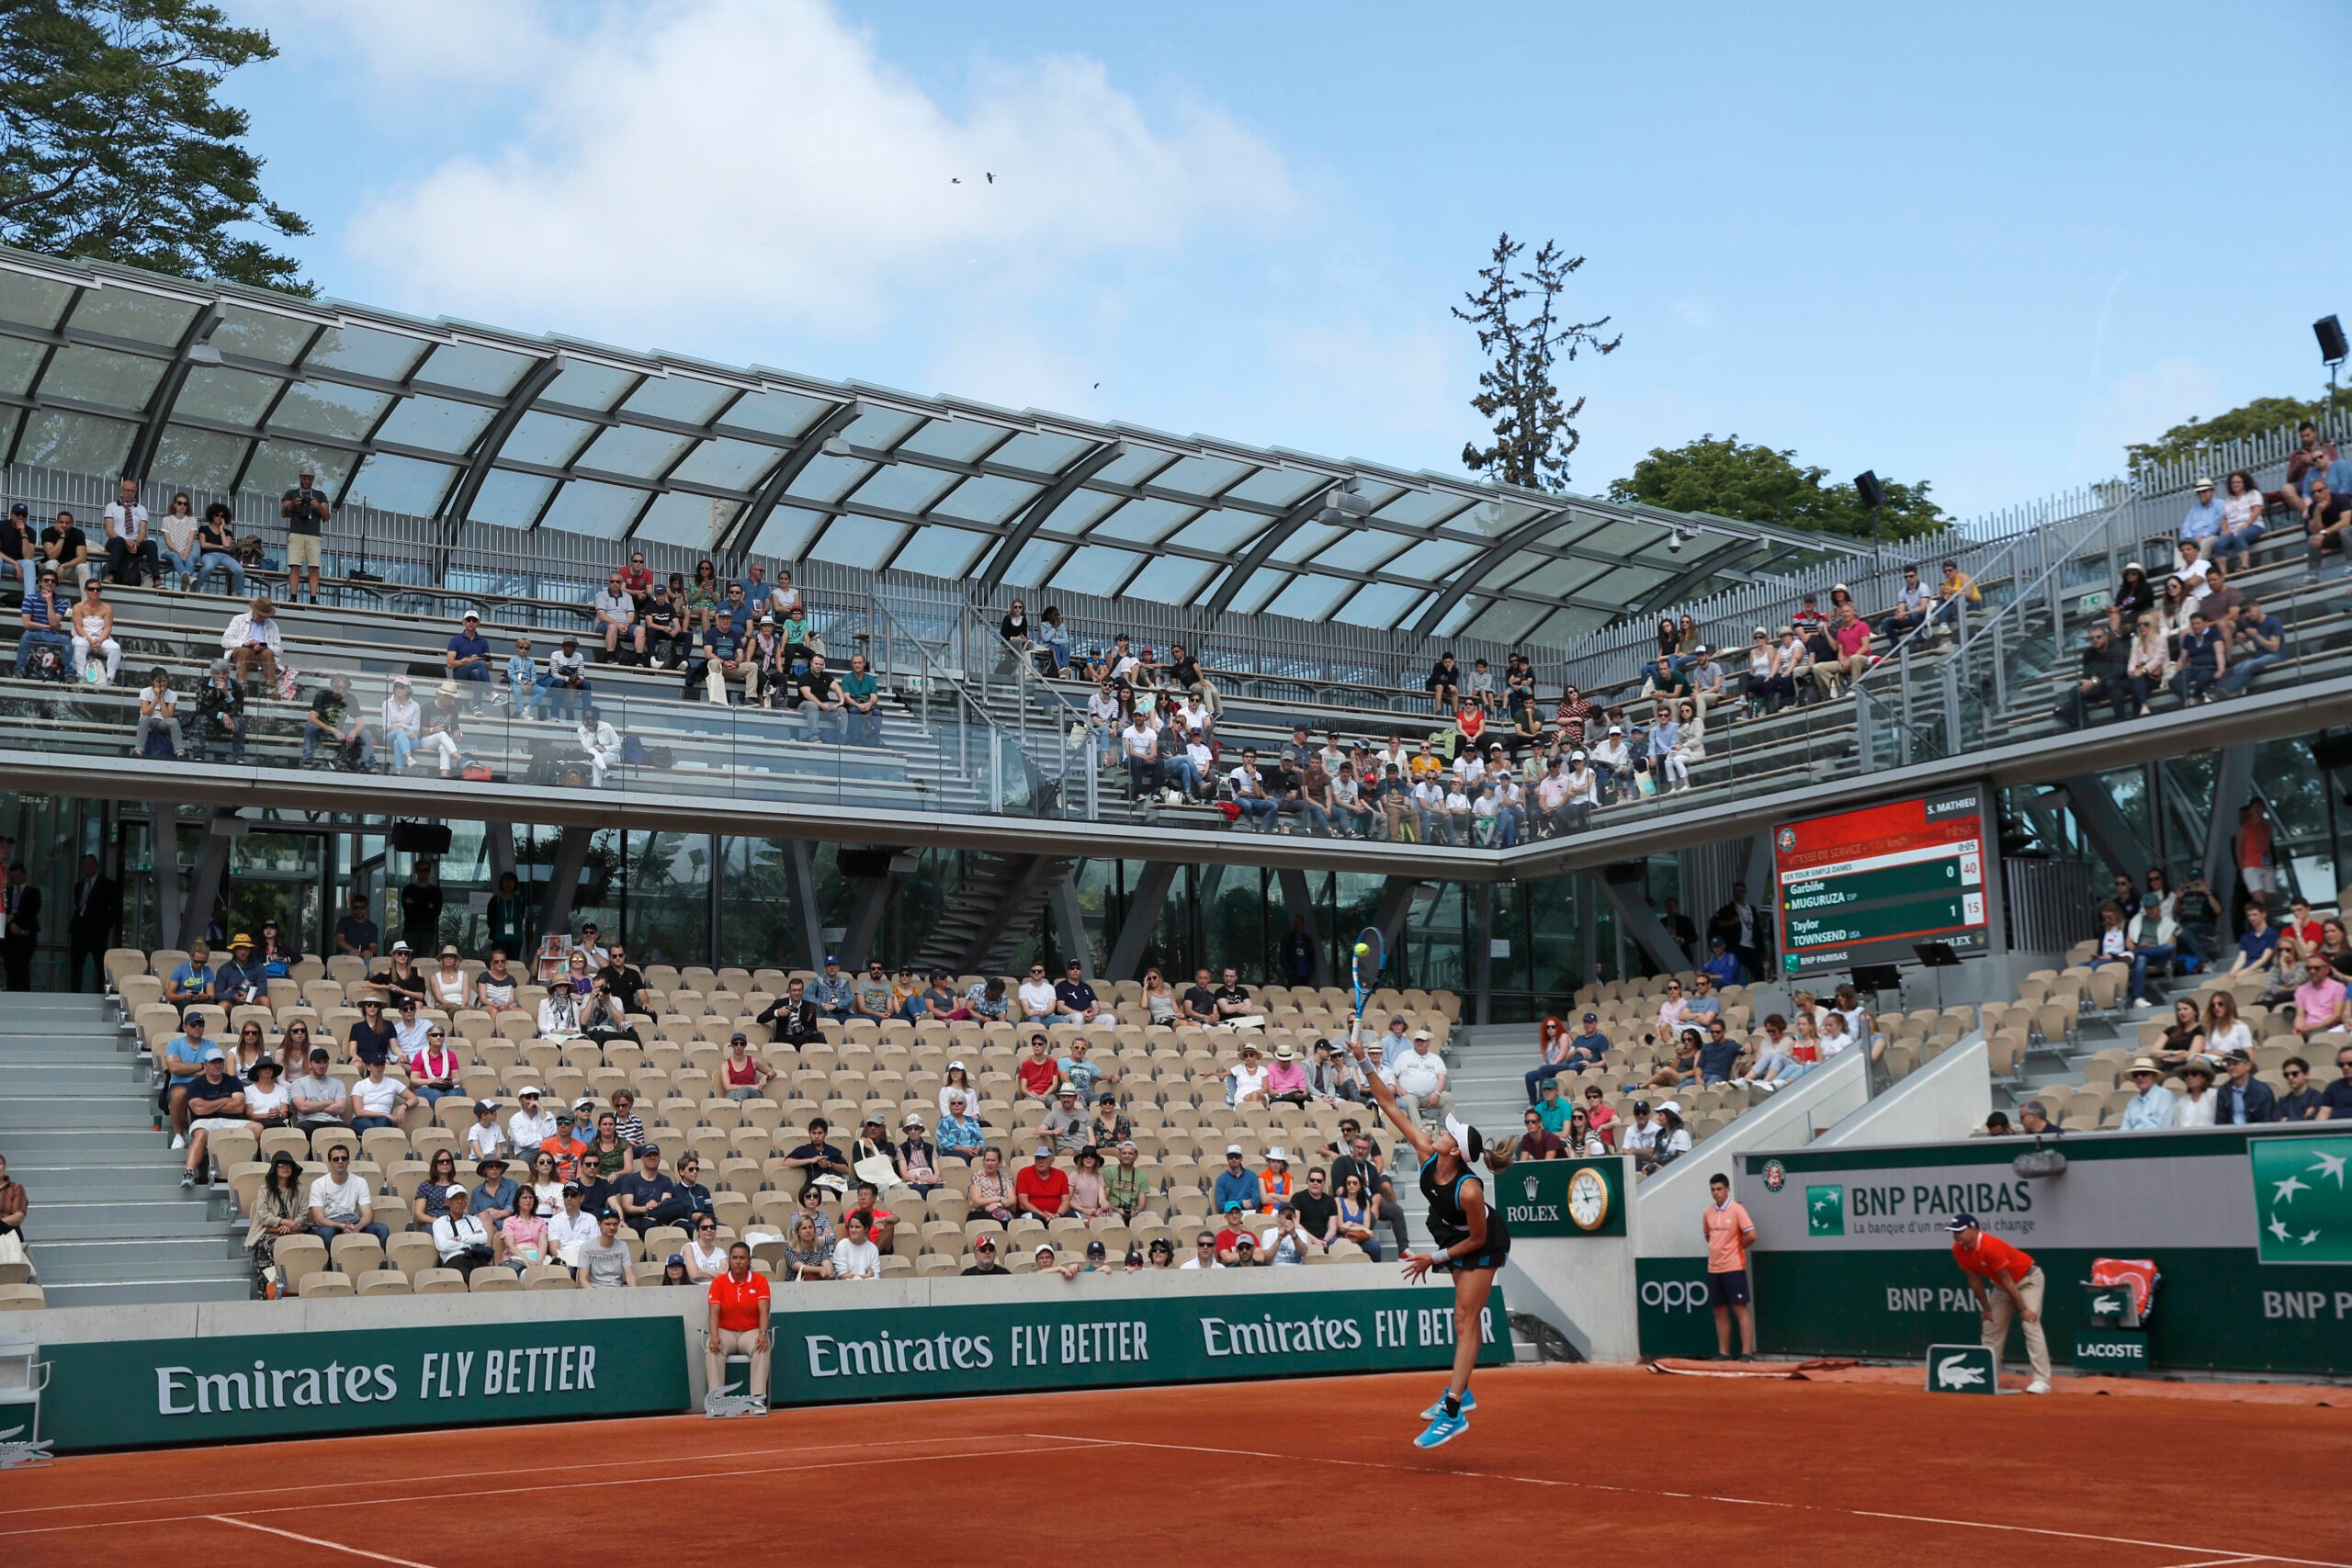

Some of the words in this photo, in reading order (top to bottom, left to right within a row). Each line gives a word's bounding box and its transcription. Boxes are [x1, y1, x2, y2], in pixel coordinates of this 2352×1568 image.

[1937, 797, 1976, 813] MATHIEU
[1788, 851, 1816, 864] VITESSE
[1818, 850, 1828, 860] DE
[1830, 844, 1861, 858] SERVICE
[1958, 840, 1975, 852] 0:05
[1794, 870, 1809, 879] TOUR
[1811, 866, 1831, 876] SIMPLE
[1832, 863, 1852, 873] DAMES
[1946, 865, 1954, 878] 0
[1963, 862, 1976, 874] 40
[1790, 881, 1825, 895] Garbiñe
[1791, 892, 1845, 909] MUGURUZA
[1949, 905, 1956, 917] 1
[1967, 902, 1979, 913] 15
[1792, 919, 1819, 933] Taylor
[1792, 930, 1847, 946] TOWNSEND
[1800, 956, 1815, 966] BNP
[1816, 952, 1848, 964] PARIBAS
[1852, 1187, 1905, 1216] BNP
[1913, 1180, 2032, 1214] PARIBAS
[1507, 1205, 1559, 1222] ROLEX
[1853, 1222, 1865, 1235] La
[1868, 1222, 1905, 1236] banque
[1908, 1220, 1931, 1233] d'un
[1995, 1218, 2035, 1235] change
[1886, 1288, 1933, 1312] BNP
[2263, 1291, 2326, 1319] BNP
[1200, 1314, 1362, 1356] Emirates
[1375, 1309, 1408, 1348] FLY
[1418, 1306, 1495, 1347] BETR
[805, 1330, 993, 1377] Emirates
[1012, 1325, 1050, 1366] FLY
[1060, 1321, 1148, 1363] BETTER
[2077, 1343, 2143, 1358] LACOSTE
[155, 1359, 398, 1415] Emirates
[420, 1351, 474, 1399] FLY
[484, 1345, 595, 1395] BETTER
